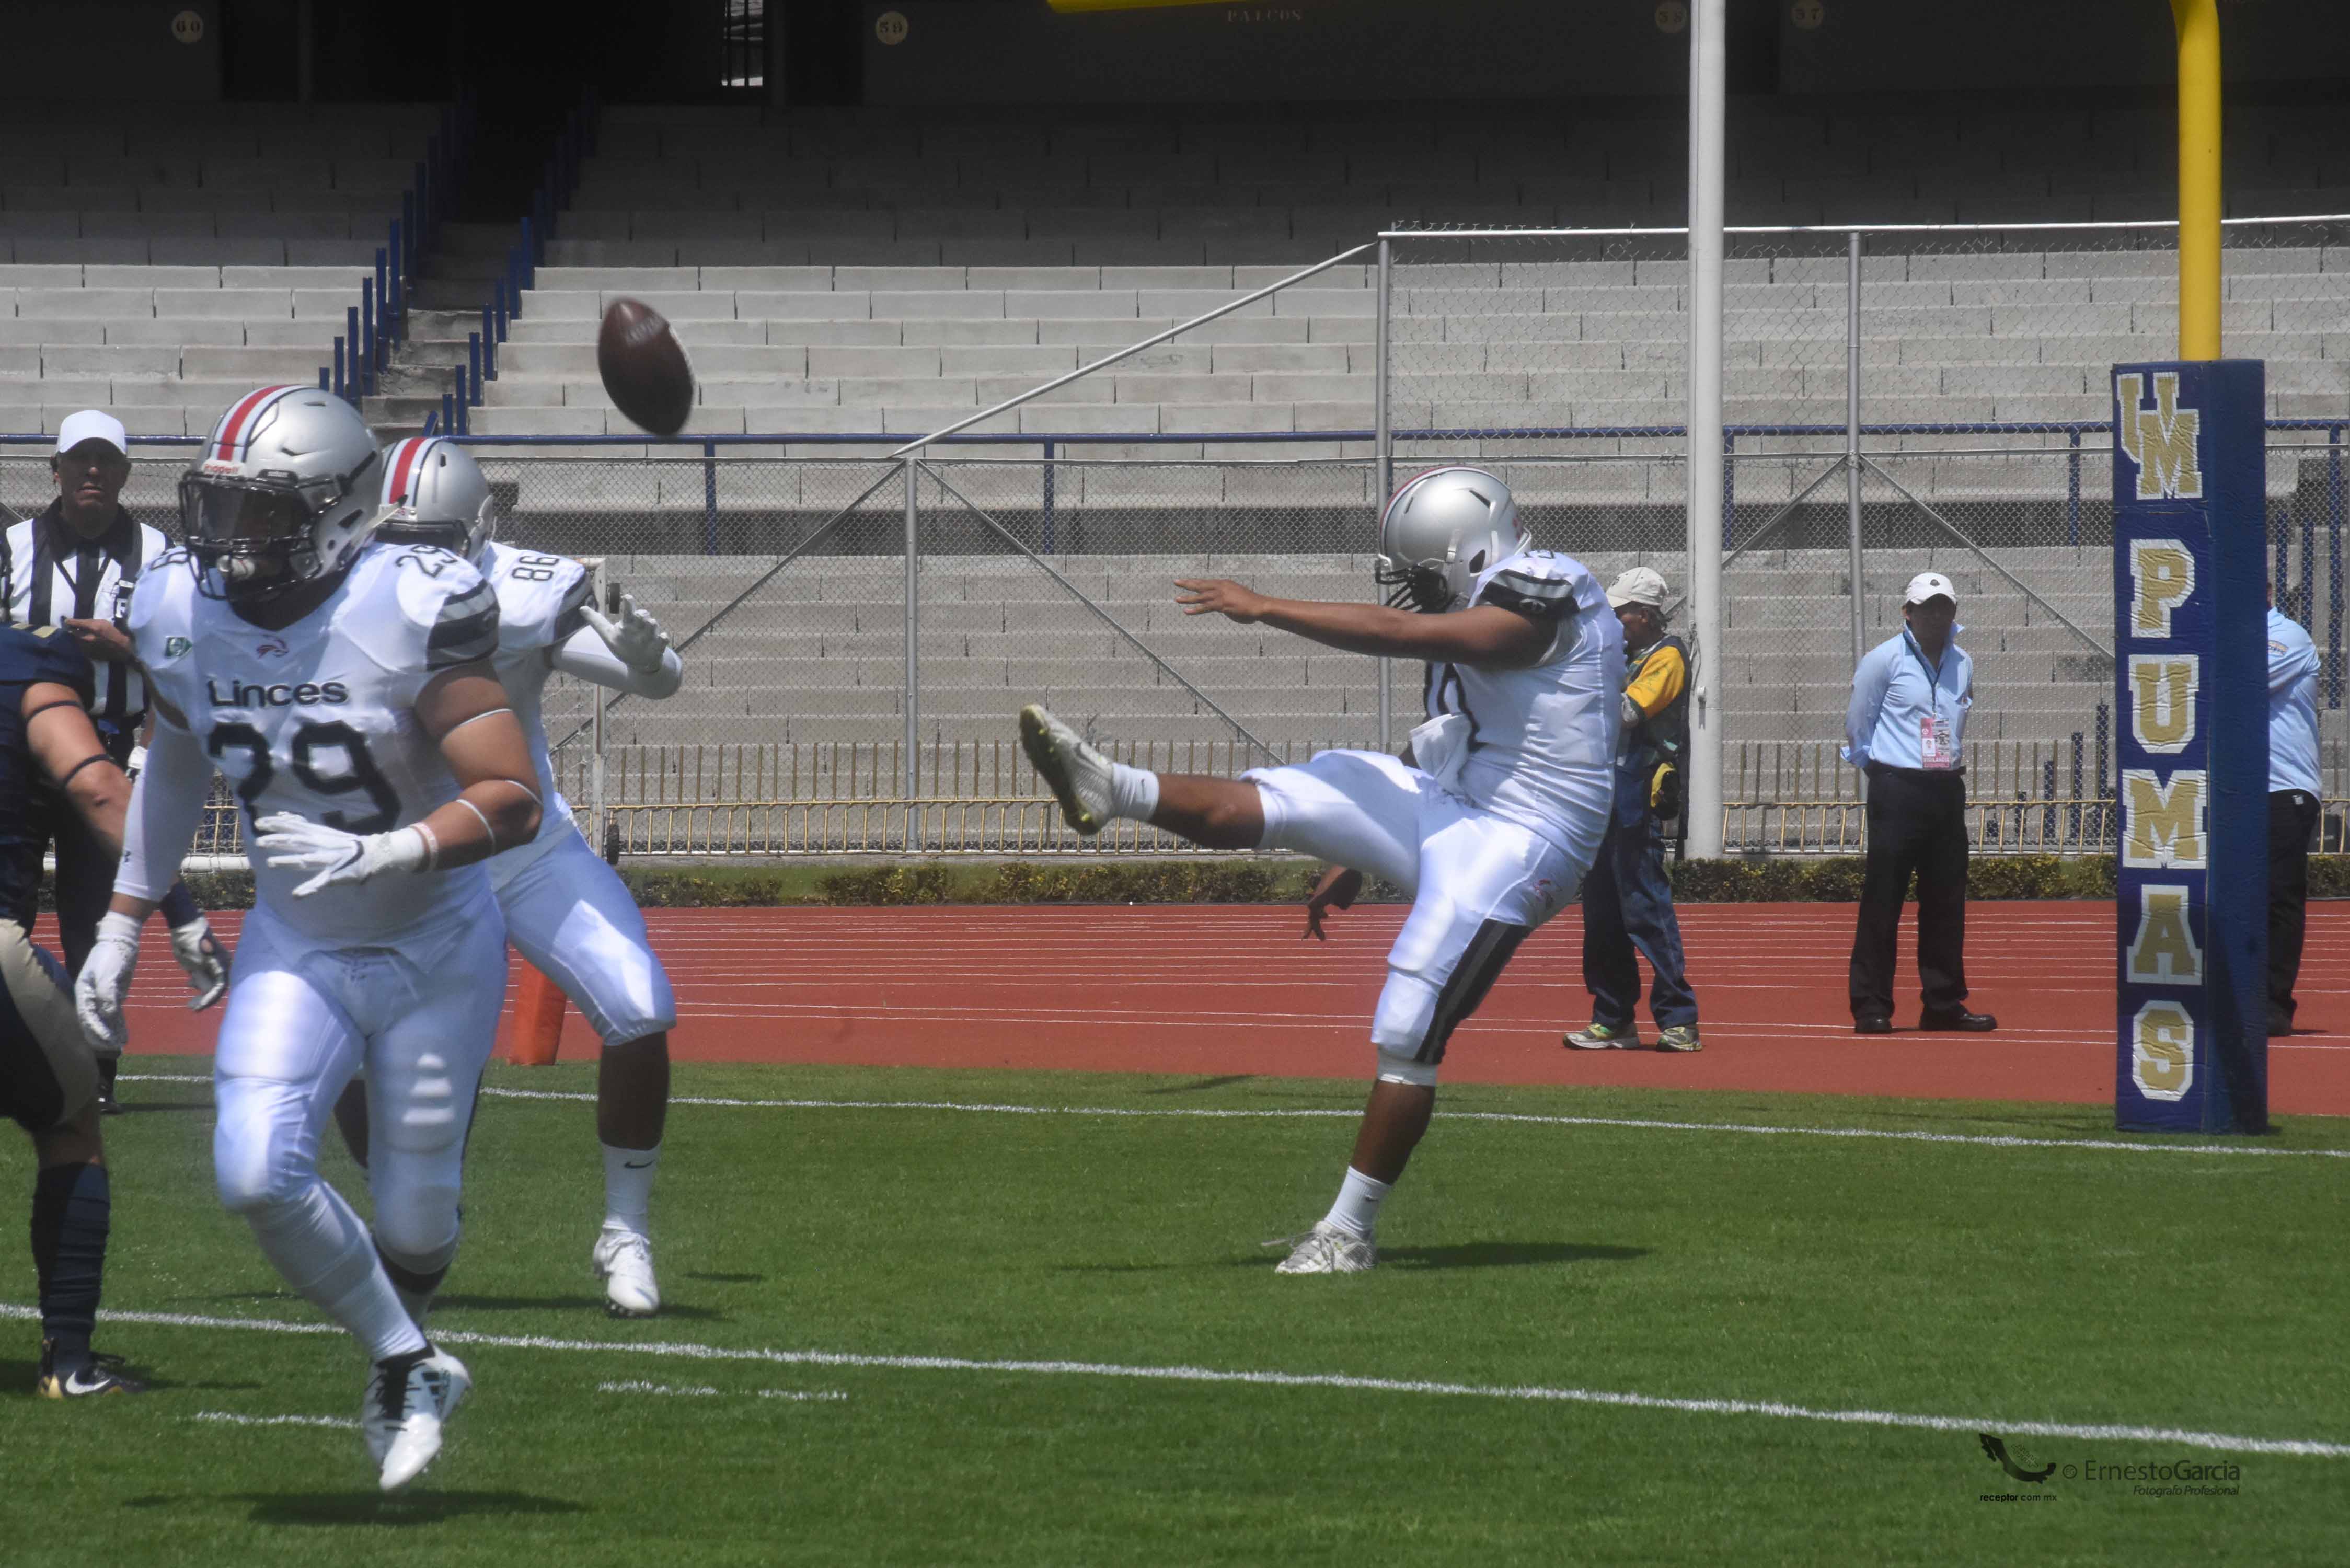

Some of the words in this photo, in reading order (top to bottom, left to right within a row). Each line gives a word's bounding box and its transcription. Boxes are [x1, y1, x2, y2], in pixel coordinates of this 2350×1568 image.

[1226, 9, 1302, 21] PALCOS
[176, 21, 201, 32] 60
[879, 21, 902, 33] 59
[395, 545, 459, 578] 29
[208, 680, 349, 707] Linces
[2122, 539, 2207, 1102] PUMAS
